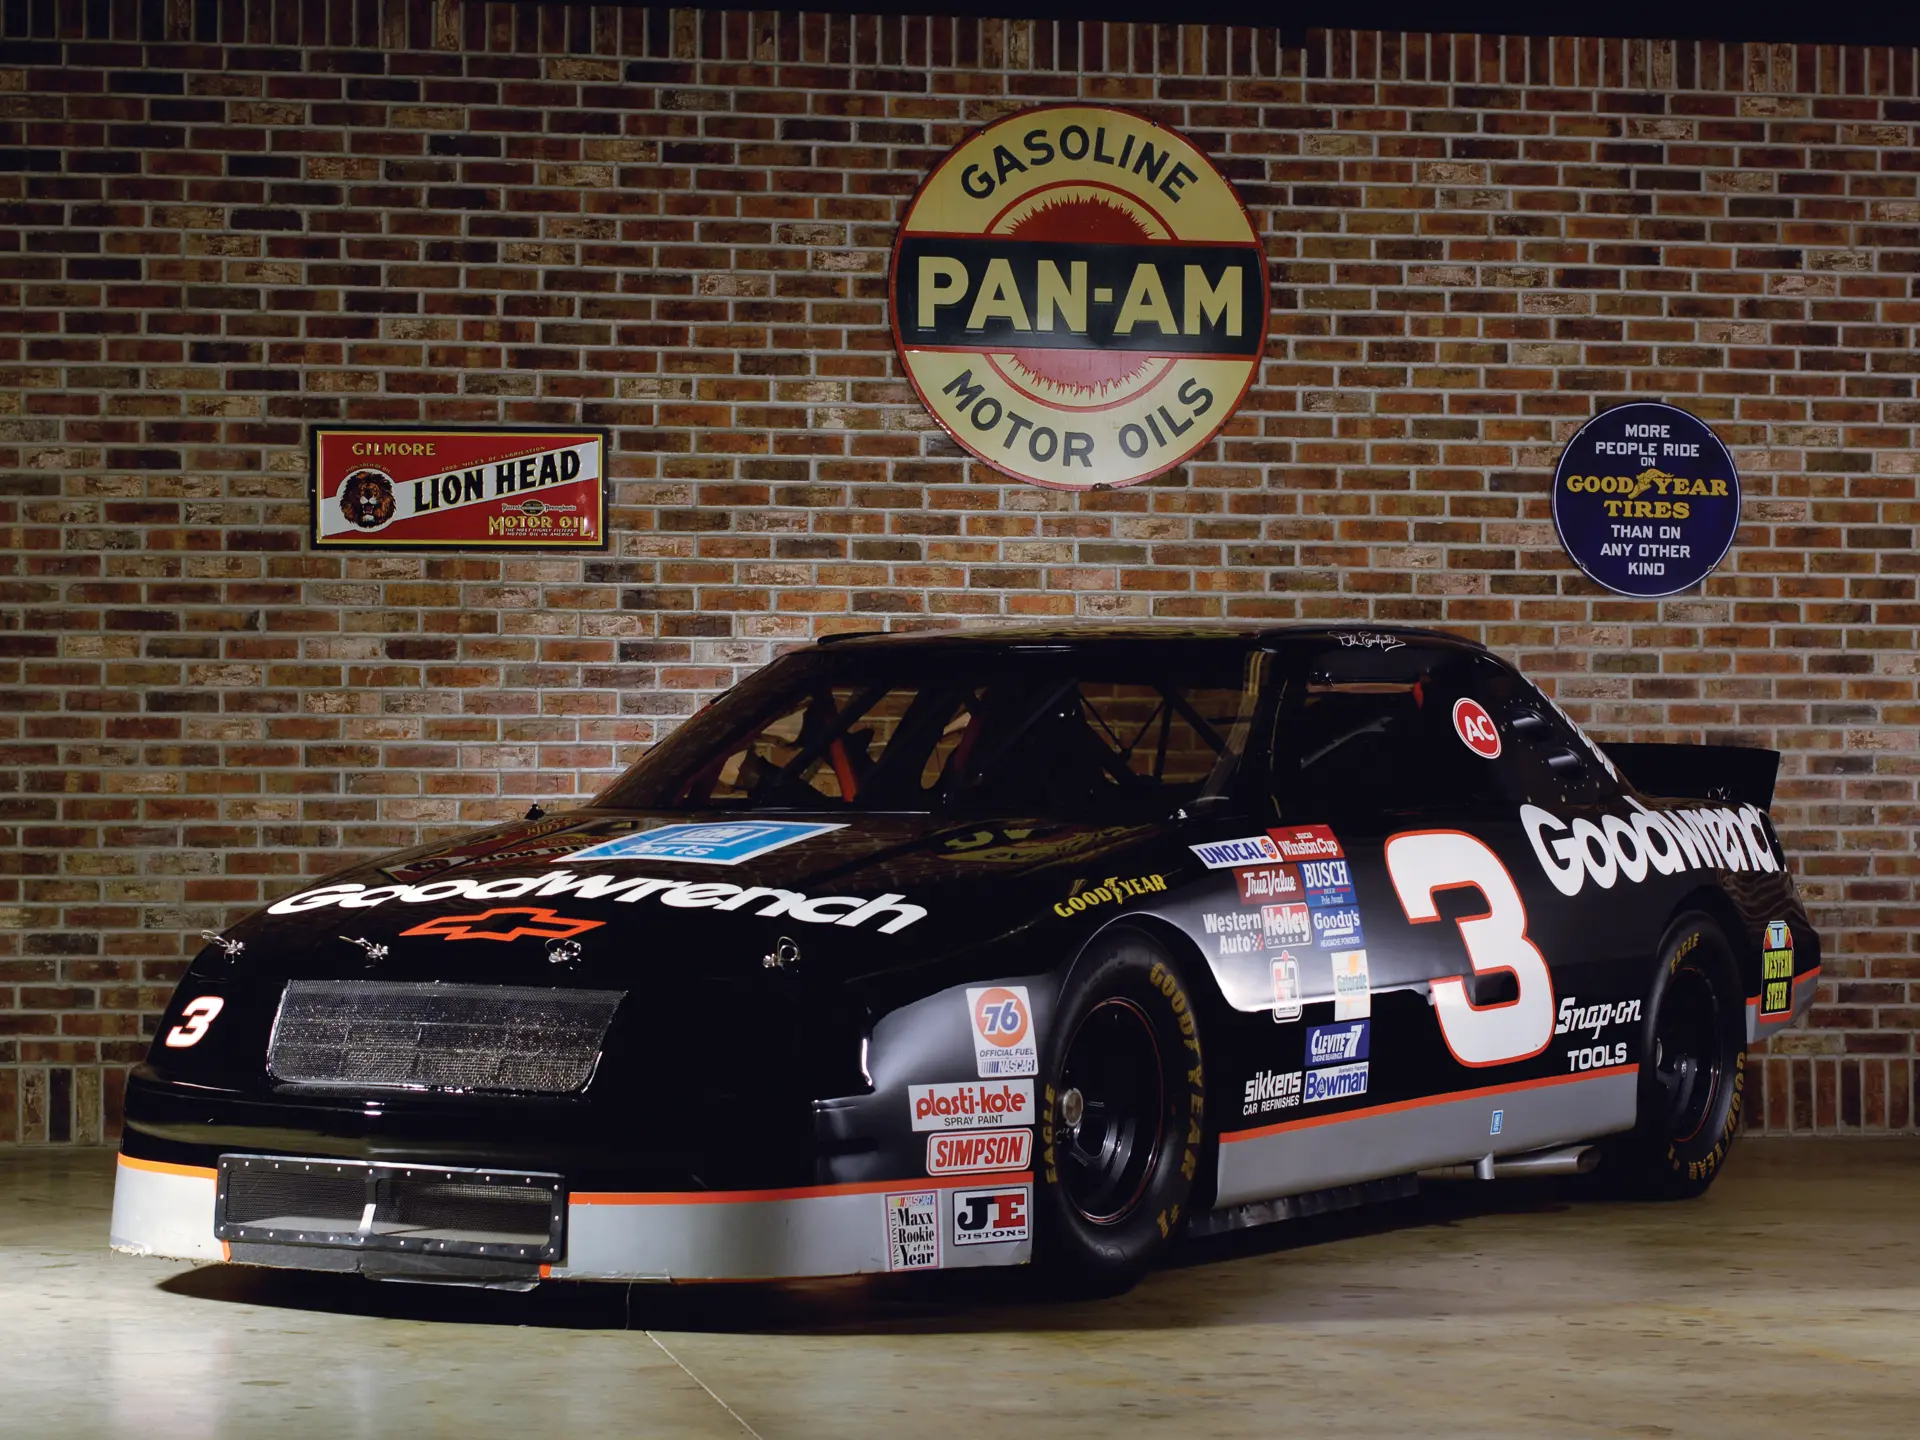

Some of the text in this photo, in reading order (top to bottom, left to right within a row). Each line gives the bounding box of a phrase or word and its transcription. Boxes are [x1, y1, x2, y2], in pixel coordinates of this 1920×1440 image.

[961, 124, 1199, 203] GASOLINE
[917, 256, 1243, 337] PAN-AM
[942, 369, 1214, 467] MOTOR OILS
[1625, 424, 1670, 438] MORE
[352, 442, 436, 456] GILMORE
[1596, 442, 1700, 457] PEOPLE RIDE
[1640, 457, 1656, 466] ON
[413, 449, 581, 513] LION HEAD
[1603, 500, 1691, 519] TIRES
[489, 515, 592, 536] MOTOR OIL
[1611, 524, 1681, 539] THAN ON
[1600, 543, 1691, 558] ANY OTHER
[1628, 562, 1665, 576] KIND
[1463, 715, 1495, 742] AC
[1197, 842, 1275, 864] UNOCAL 76
[1278, 838, 1338, 856] Winston Cup
[1242, 869, 1297, 897] True Value
[1302, 861, 1349, 888] BUSCH
[267, 870, 928, 934] Goodwrench
[1053, 873, 1168, 918] GOODYEAR
[1202, 911, 1262, 934] Western
[1263, 906, 1310, 941] Holley
[1313, 910, 1361, 933] Goody's
[1219, 933, 1252, 955] Auto
[1771, 927, 1784, 942] T
[1384, 829, 1555, 1068] 3
[1671, 932, 1700, 975] EAGLE
[165, 996, 225, 1047] 3
[983, 1001, 1021, 1035] 76
[1555, 997, 1641, 1039] Snap-on
[980, 1049, 1013, 1058] OFFICIAL
[1015, 1048, 1034, 1056] FUEL
[1311, 1029, 1345, 1055] CLEVITE
[999, 1060, 1035, 1073] NASCAR
[1567, 1042, 1627, 1071] TOOLS
[1305, 1071, 1367, 1100] Bowman
[916, 1085, 1026, 1120] plasti-kote
[1243, 1095, 1300, 1115] CAR REFINISHES
[944, 1114, 1004, 1127] SPRAY PAINT
[1043, 1084, 1057, 1183] EAGLE
[935, 1135, 1025, 1168] SIMPSON
[898, 1208, 934, 1227] Maxx
[957, 1193, 1026, 1230] JE
[898, 1226, 934, 1244] Rookie
[957, 1229, 1026, 1241] PISTONS
[900, 1244, 934, 1266] Year
[913, 1244, 920, 1252] of
